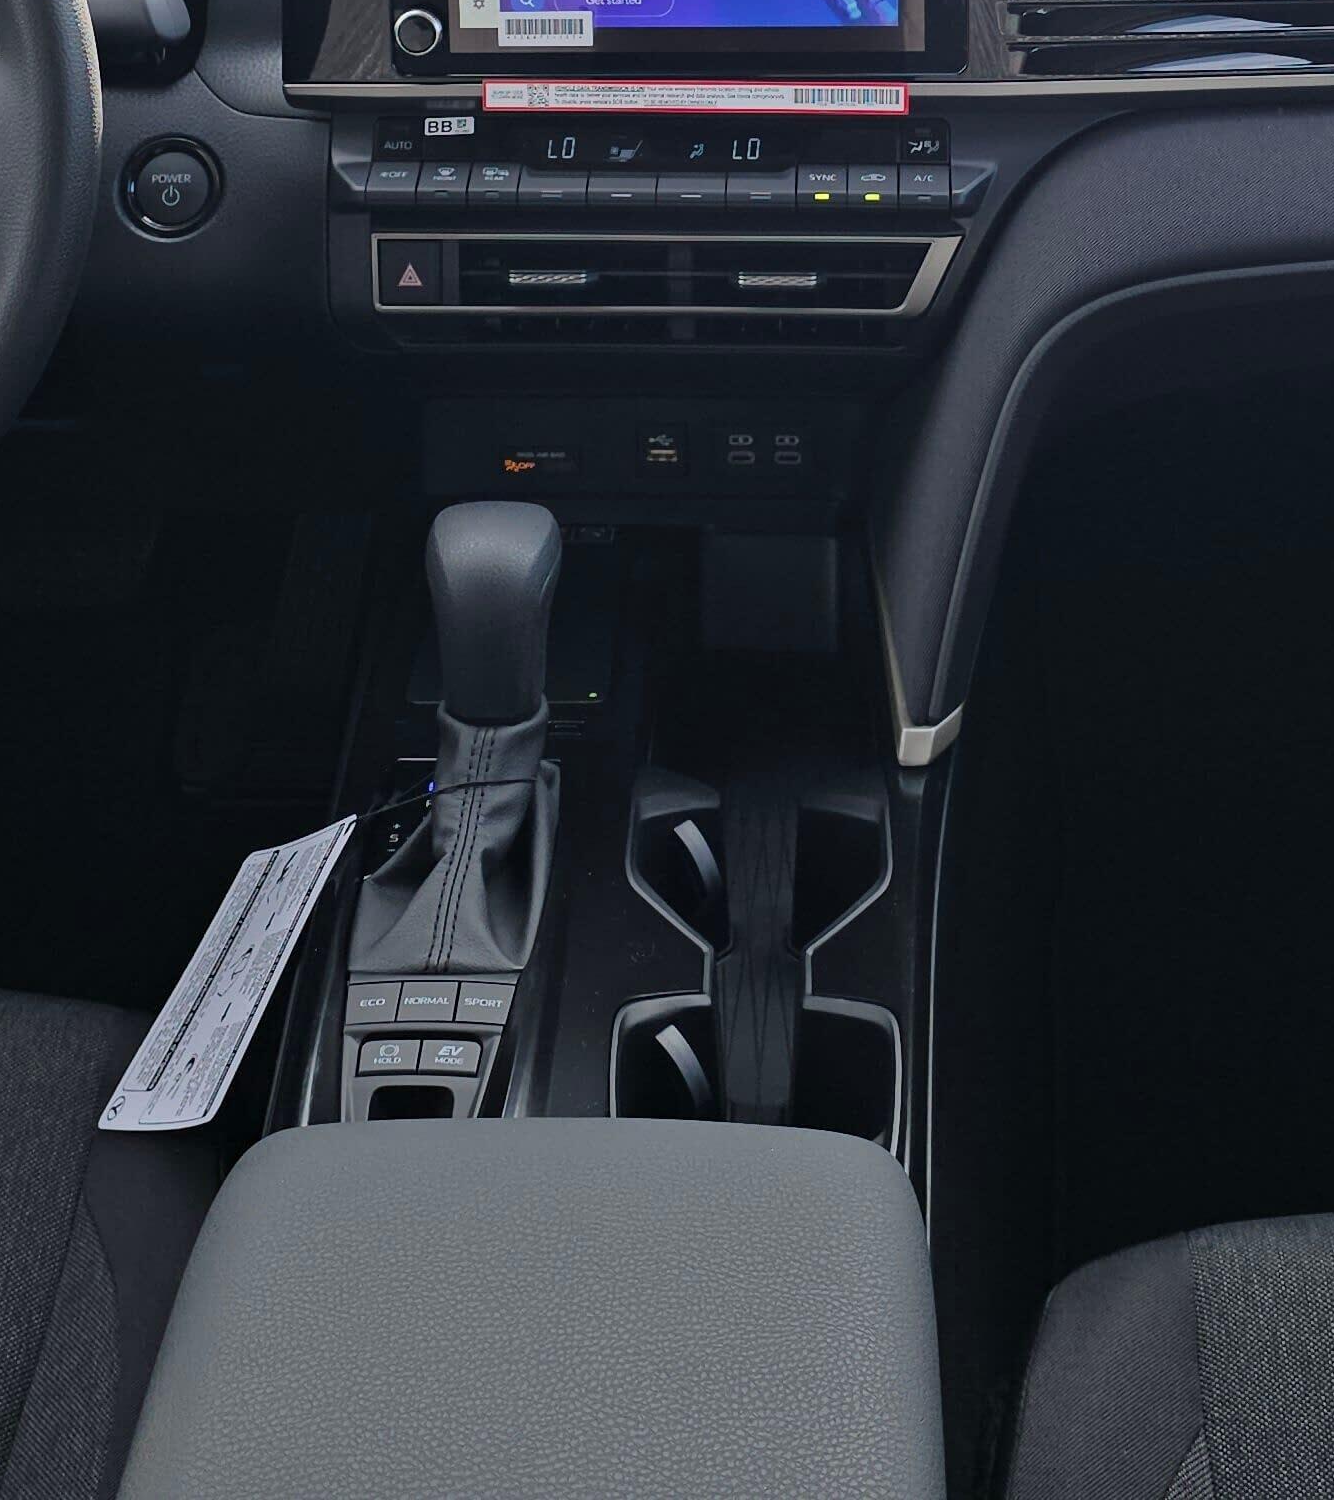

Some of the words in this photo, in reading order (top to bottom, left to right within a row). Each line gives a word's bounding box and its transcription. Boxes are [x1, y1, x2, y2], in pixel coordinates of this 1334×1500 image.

[427, 120, 453, 133] BB
[384, 141, 413, 150] AUTO
[547, 136, 576, 159] LO
[732, 137, 761, 160] LO
[151, 173, 191, 184] POWER
[809, 173, 837, 182] SYNC
[914, 174, 934, 182] A/C
[388, 833, 399, 843] S
[359, 998, 386, 1007] ECO
[404, 997, 450, 1005] NORMAL
[464, 997, 503, 1008] SPORT
[438, 1045, 464, 1056] EV
[373, 1057, 402, 1065] HOLD
[434, 1057, 464, 1065] MODE
